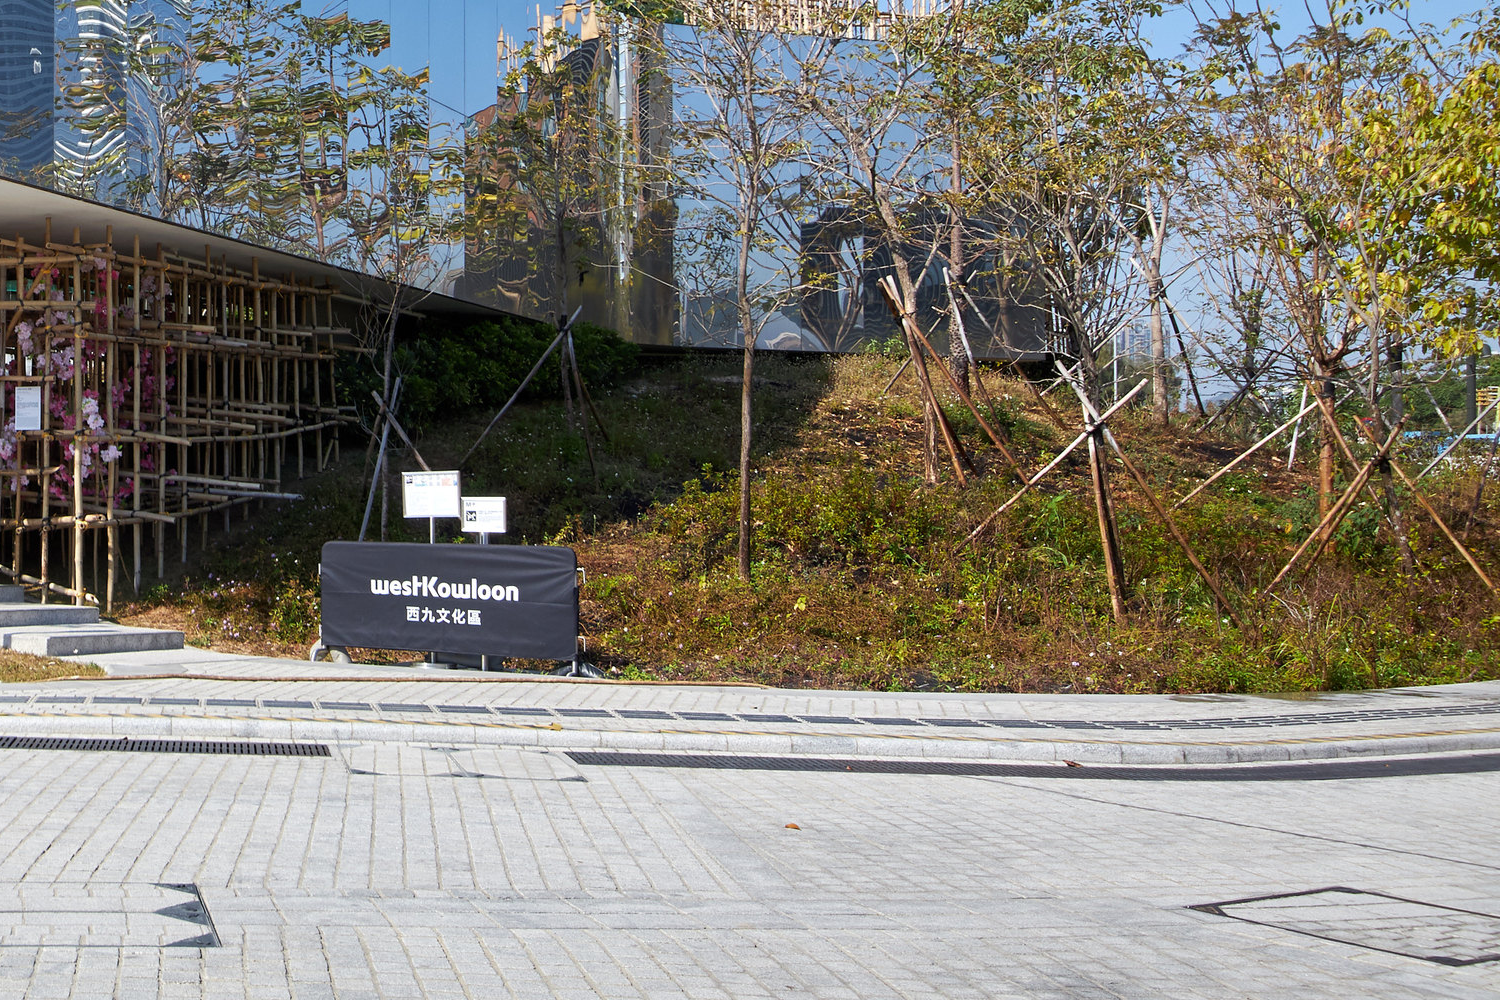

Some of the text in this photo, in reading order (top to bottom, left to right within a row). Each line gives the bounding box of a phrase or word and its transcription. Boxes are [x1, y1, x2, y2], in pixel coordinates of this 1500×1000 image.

[406, 606, 481, 625] 西九文化區
